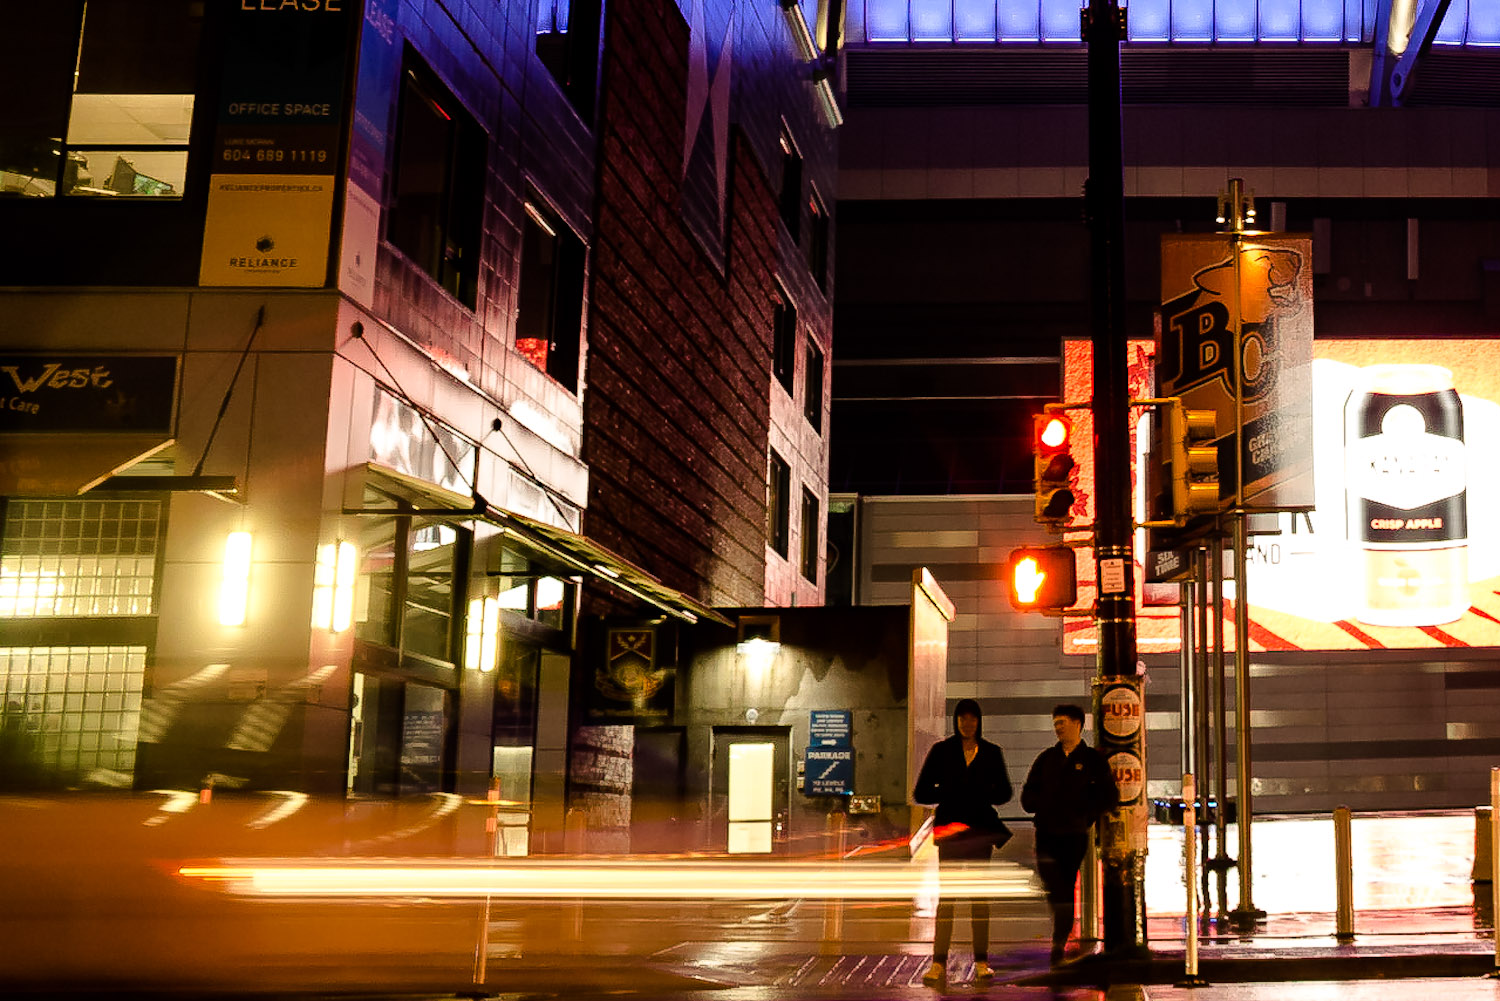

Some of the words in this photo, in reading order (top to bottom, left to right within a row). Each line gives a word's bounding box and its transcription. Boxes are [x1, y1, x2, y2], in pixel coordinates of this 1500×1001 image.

[228, 103, 280, 117] OFFICE
[283, 103, 331, 117] SPACE
[223, 149, 251, 161] 604
[291, 150, 327, 163] 1119
[229, 258, 298, 268] RELIANCE
[0, 362, 114, 394] West
[1370, 518, 1404, 531] CRISP
[1405, 517, 1444, 530] APPLE
[1113, 767, 1142, 783] USE
